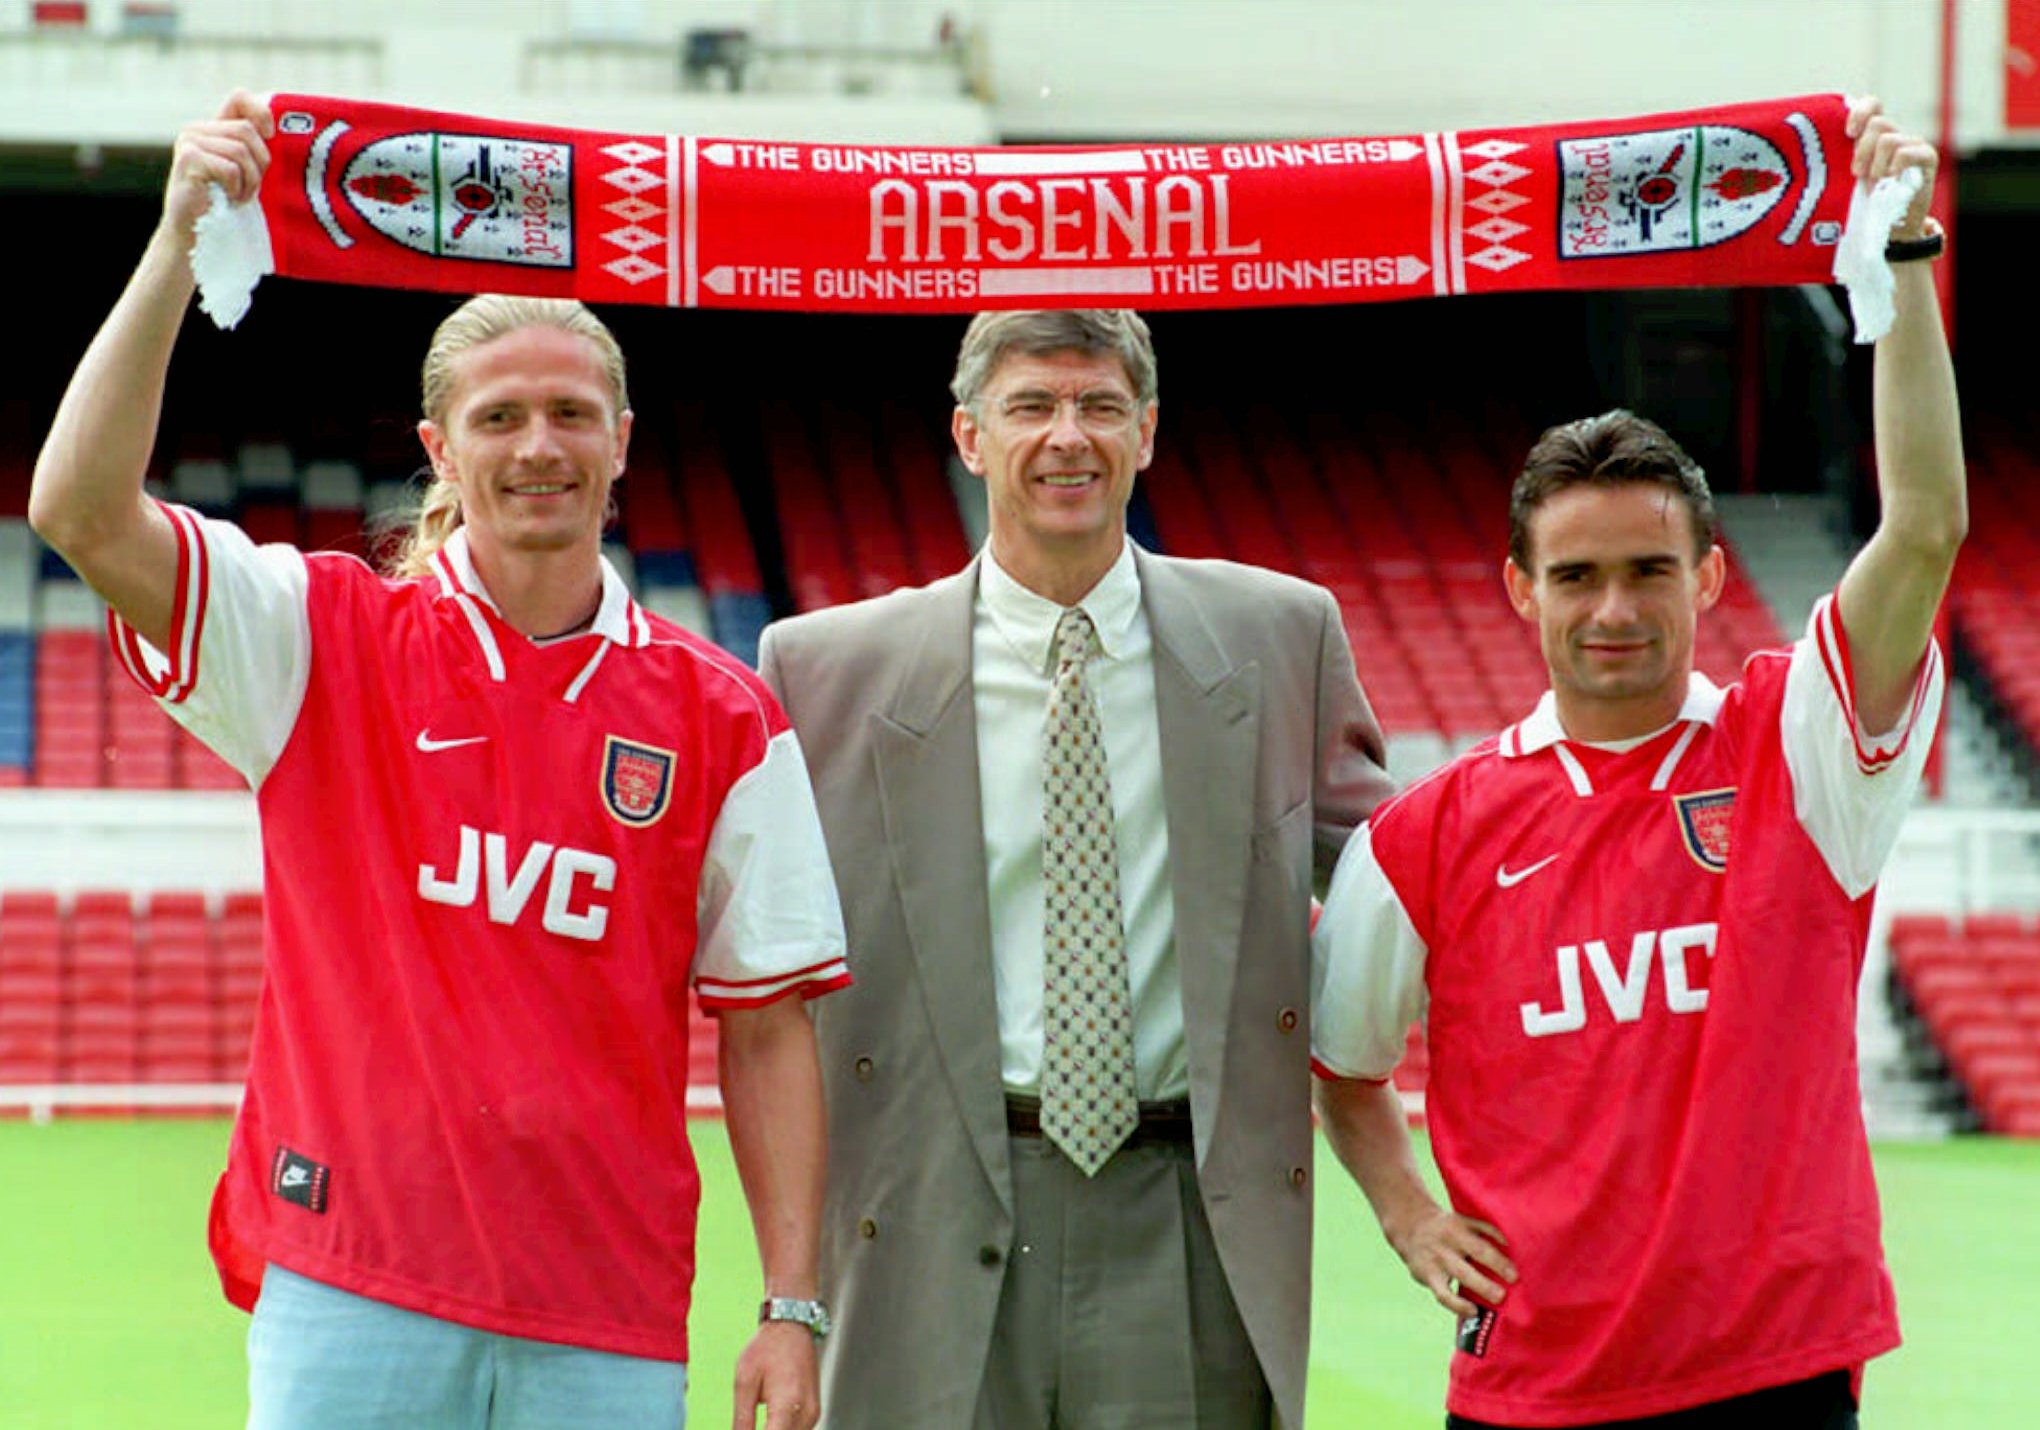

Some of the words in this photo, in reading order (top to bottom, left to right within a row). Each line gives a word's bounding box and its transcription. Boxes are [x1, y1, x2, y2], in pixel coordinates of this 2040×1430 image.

[736, 144, 799, 170] THE
[812, 148, 974, 174] GUNNERS
[1146, 148, 1211, 171] THE
[1222, 140, 1389, 169] GUNNERS
[866, 174, 1262, 262] ARSENAL
[736, 266, 802, 297] THE
[813, 268, 978, 299] GUNNERS
[1153, 264, 1219, 294] THE
[1231, 256, 1397, 291] GUNNERS
[417, 824, 617, 941] JVC
[1519, 922, 1719, 1037] JVC
